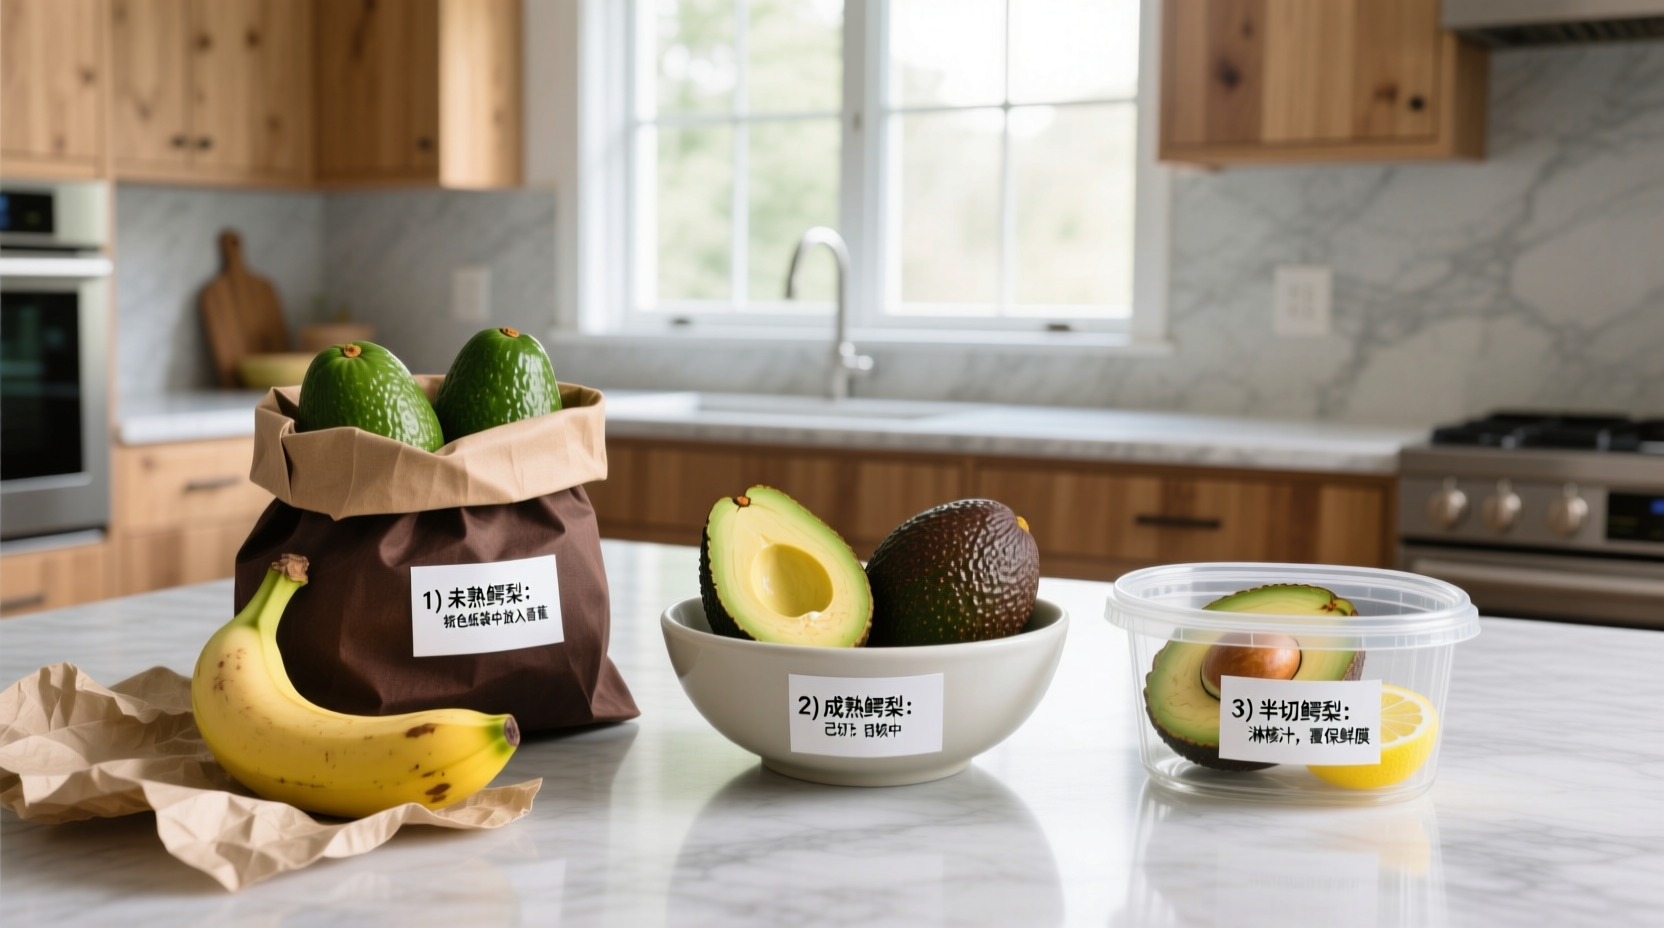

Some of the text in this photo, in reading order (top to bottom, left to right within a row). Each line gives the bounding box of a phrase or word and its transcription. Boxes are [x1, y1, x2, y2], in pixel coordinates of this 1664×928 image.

[423, 590, 442, 614] 1)
[798, 696, 819, 721] 2)
[1231, 698, 1253, 723] 3)
